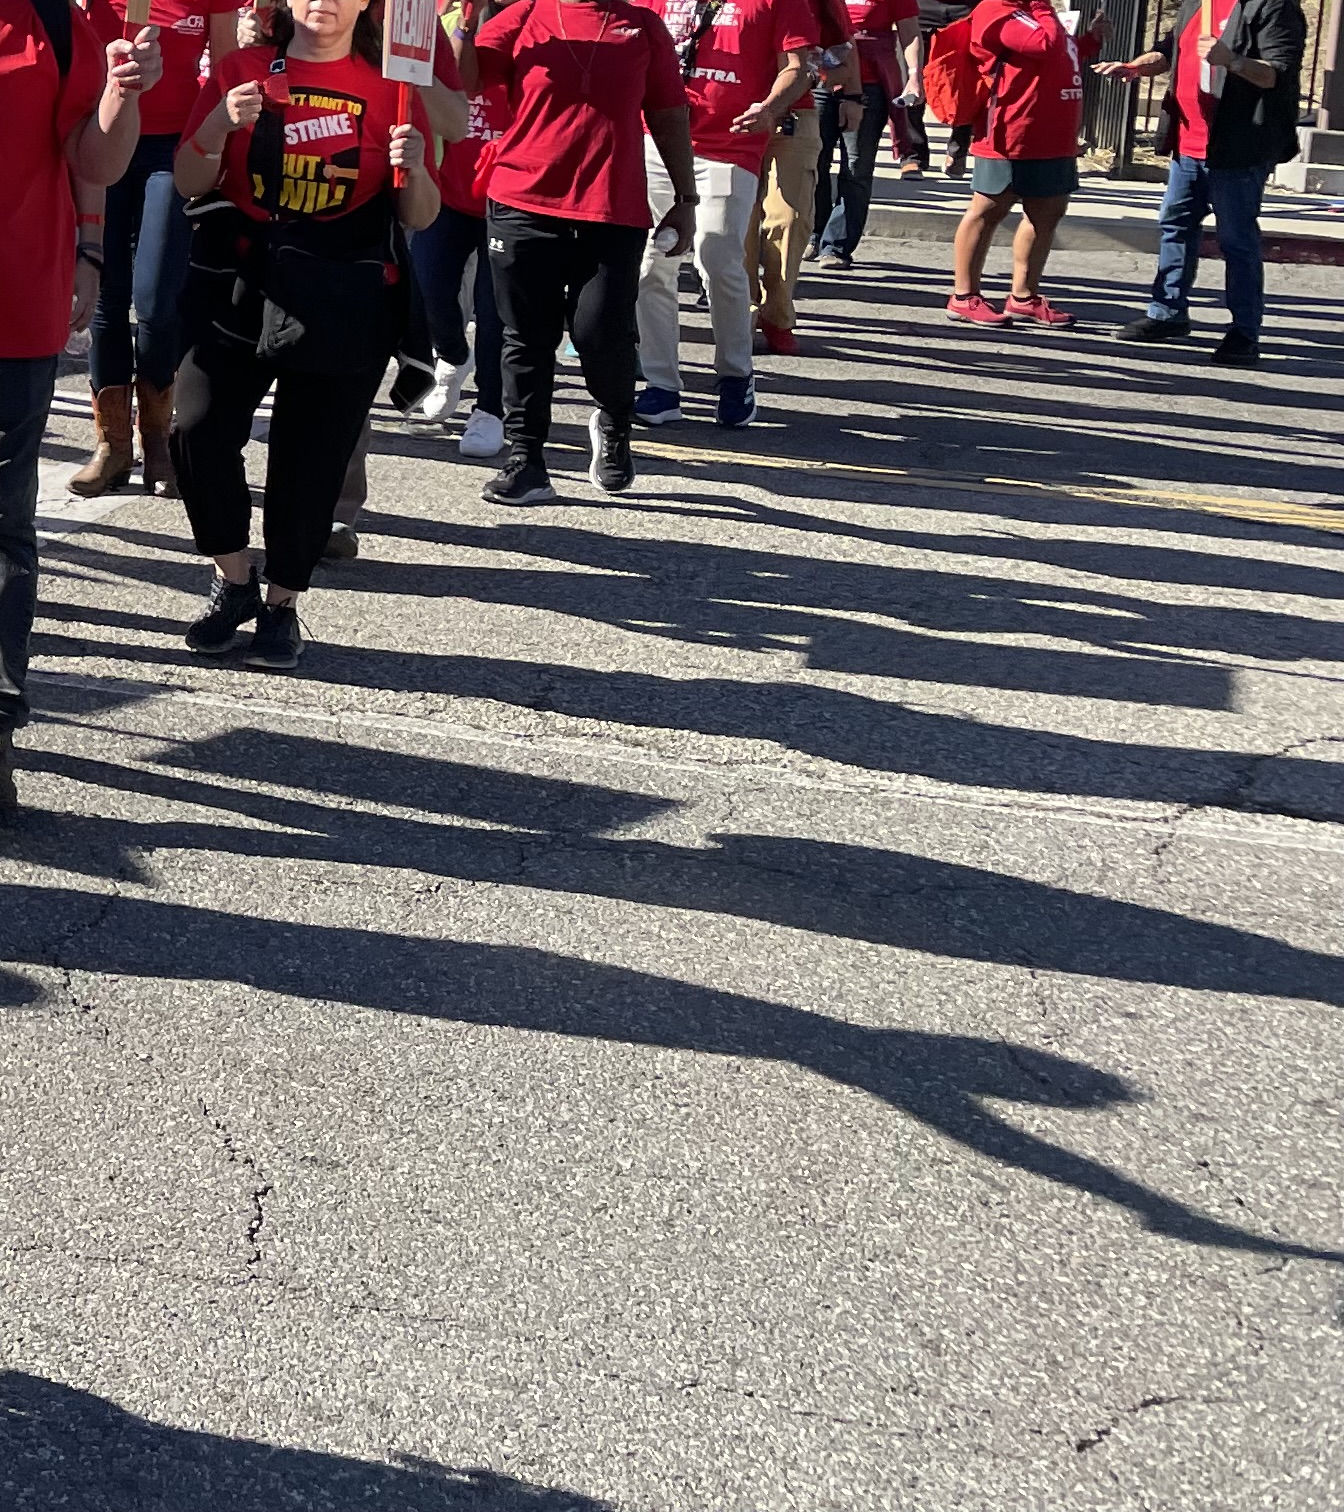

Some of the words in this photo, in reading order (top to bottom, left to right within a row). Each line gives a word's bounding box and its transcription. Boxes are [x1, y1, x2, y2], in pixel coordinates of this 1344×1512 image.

[308, 94, 345, 111] WANT
[346, 100, 362, 116] TO
[283, 112, 354, 145] STRIKE
